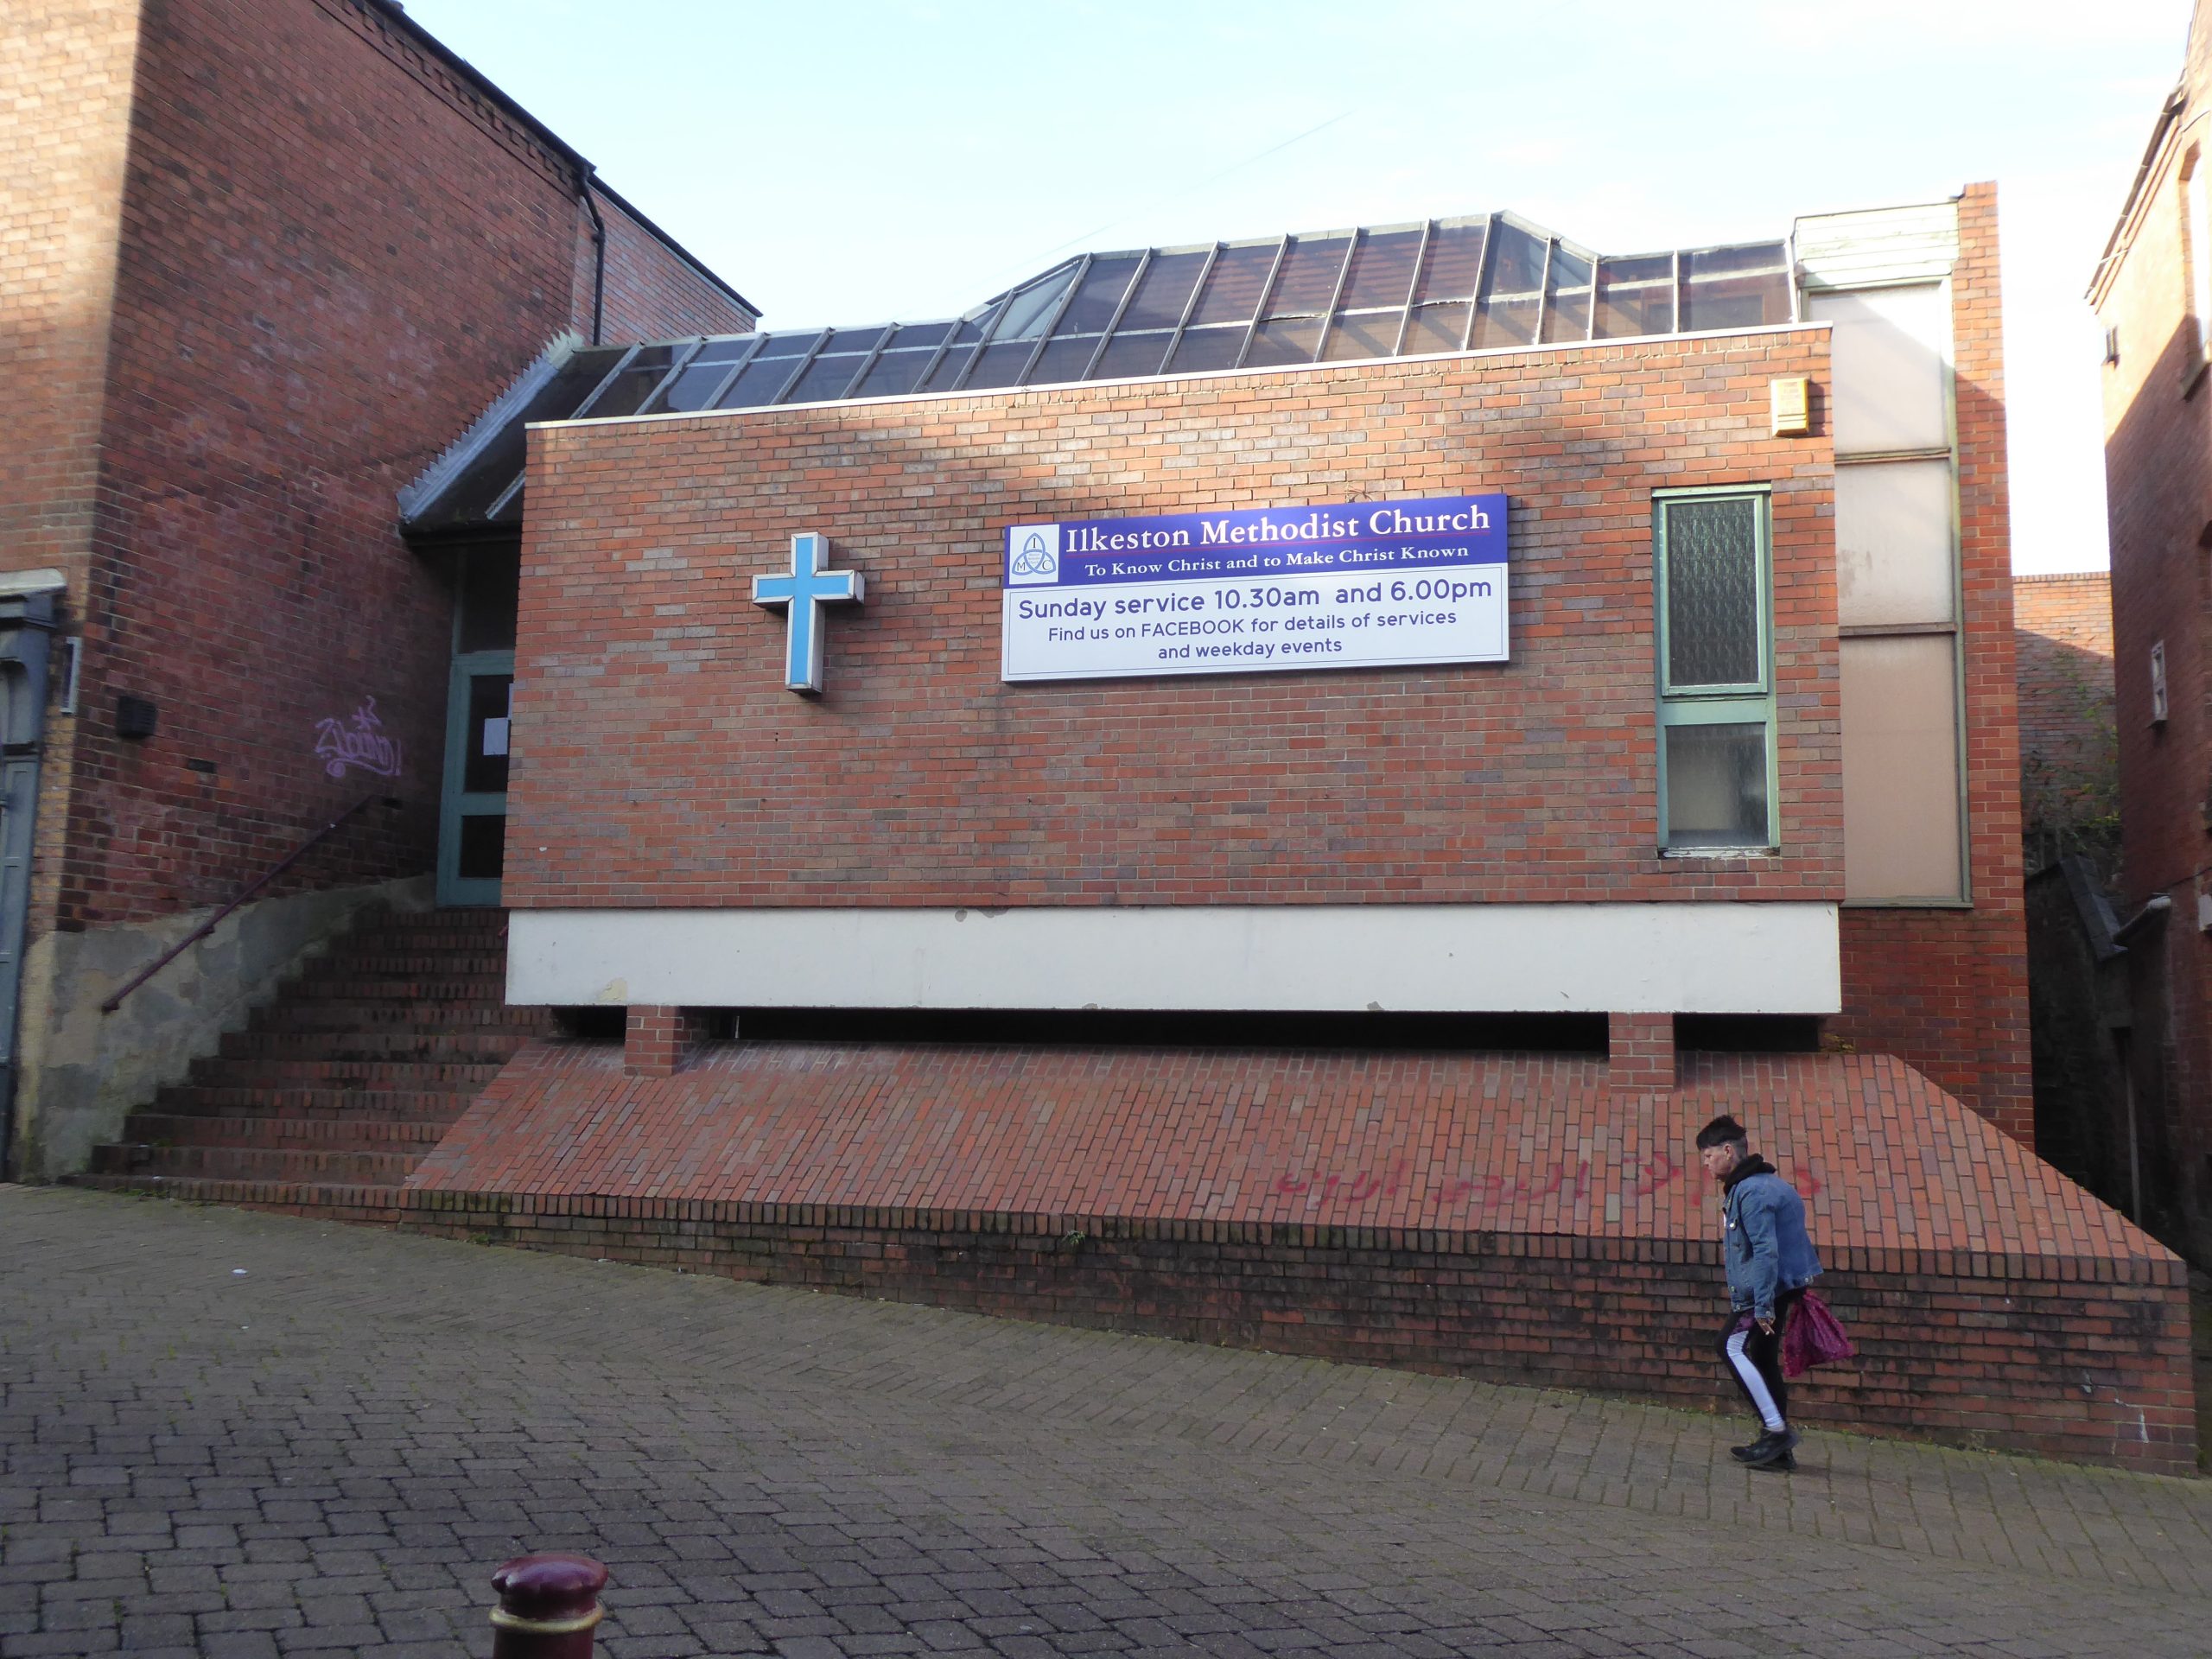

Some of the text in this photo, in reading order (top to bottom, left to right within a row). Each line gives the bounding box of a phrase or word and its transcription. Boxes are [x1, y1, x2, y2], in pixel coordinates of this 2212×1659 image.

[1065, 504, 1491, 553] Ilkeston Methodist Church
[1084, 546, 1469, 576] To Know Christ and to Make Christ Known
[1019, 578, 1491, 621] Sunday service 10.30am and 6.00pm
[1048, 610, 1457, 642] Find us on FACEBOOK for details of services
[1158, 638, 1343, 659] and weekday events
